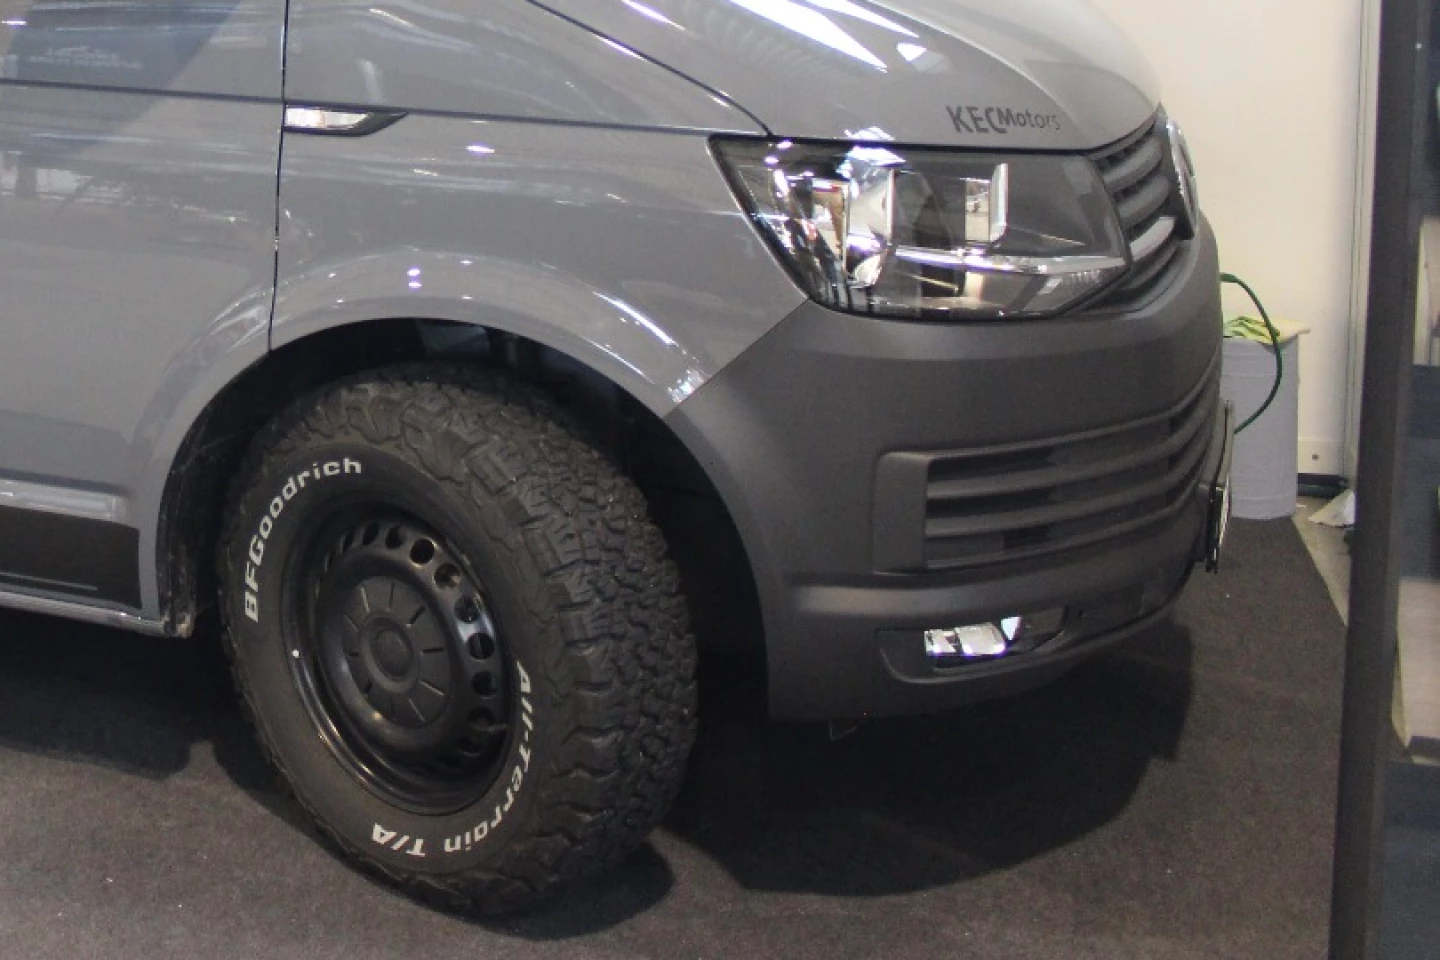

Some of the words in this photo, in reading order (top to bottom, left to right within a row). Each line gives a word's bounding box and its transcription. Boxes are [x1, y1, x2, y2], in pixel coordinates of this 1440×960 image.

[244, 457, 362, 623] BFGoodrich
[443, 660, 534, 853] All-Terrain
[371, 822, 426, 858] T/A
